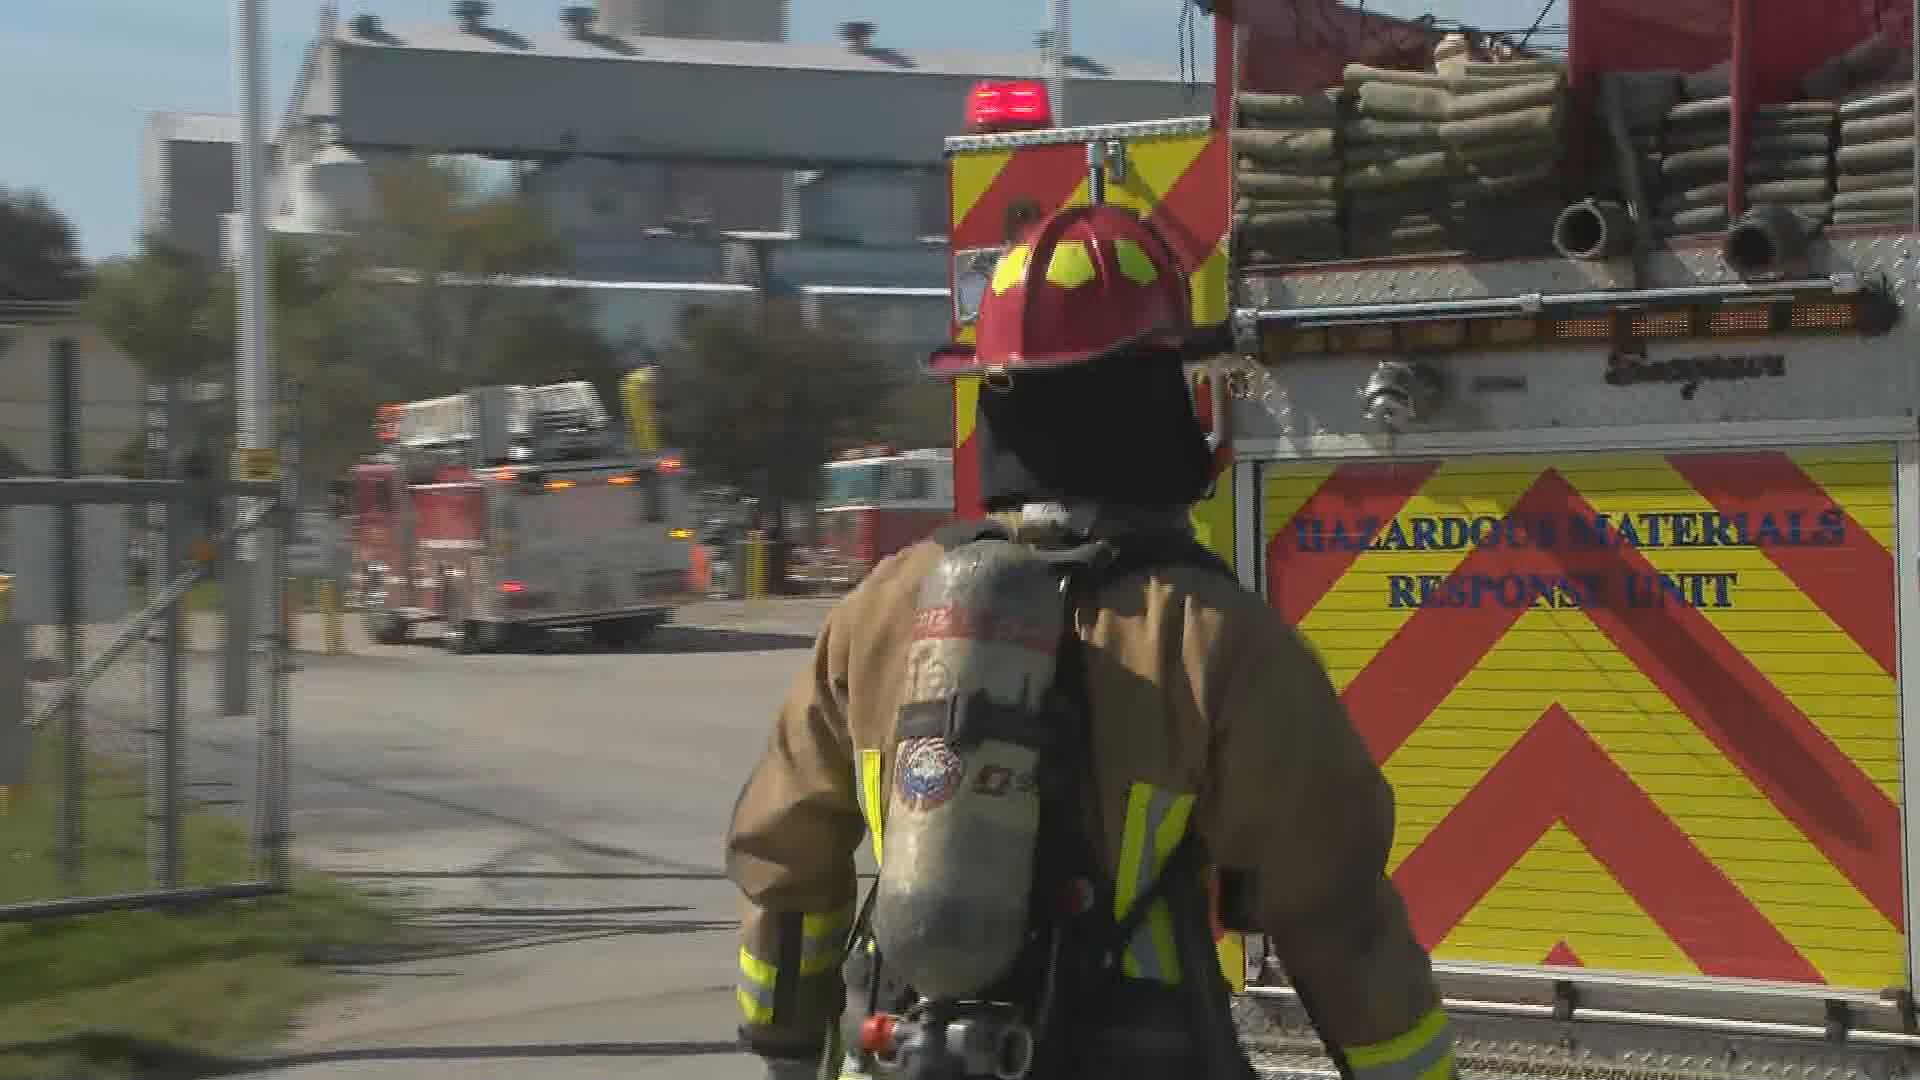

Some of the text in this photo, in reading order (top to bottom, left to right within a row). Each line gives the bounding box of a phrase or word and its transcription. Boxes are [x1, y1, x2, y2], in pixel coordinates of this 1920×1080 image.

[1295, 509, 1845, 552] HAZARDOUS MATERIALS
[1387, 572, 1738, 608] RESPONSE UNIT
